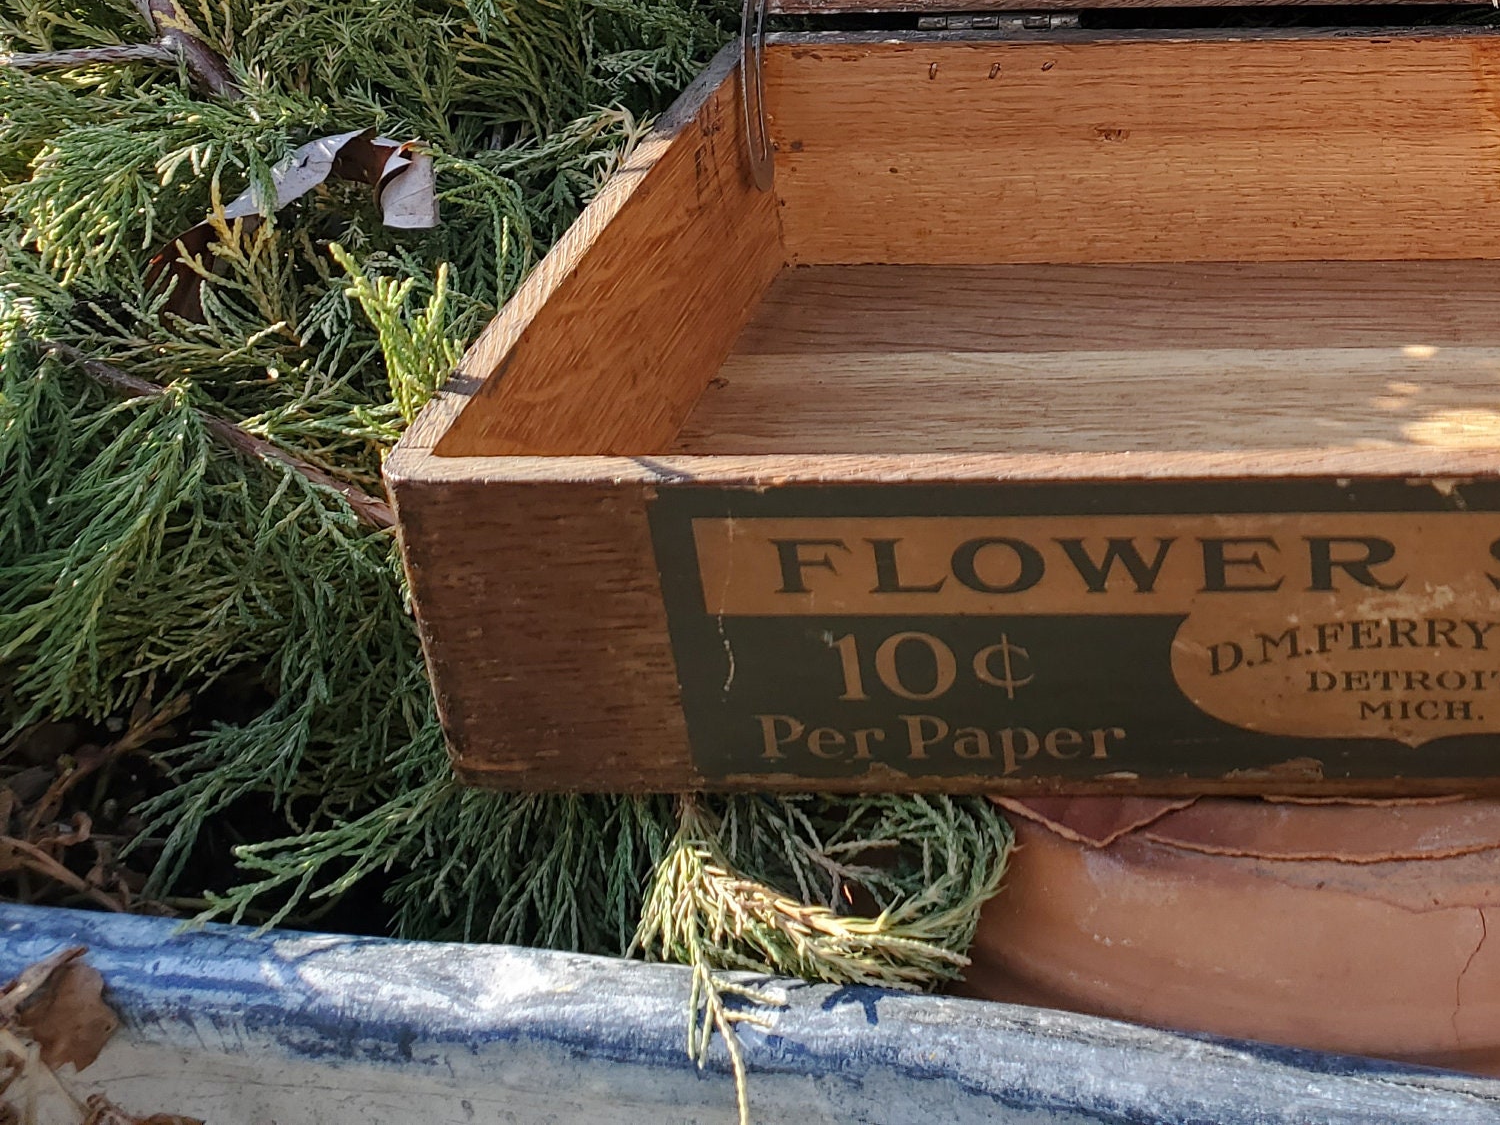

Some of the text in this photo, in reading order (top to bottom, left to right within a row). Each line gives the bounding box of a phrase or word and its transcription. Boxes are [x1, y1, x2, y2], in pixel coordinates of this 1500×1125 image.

[767, 534, 1408, 594] FLOWER
[1357, 698, 1485, 721] MICH.
[754, 714, 1126, 773] Per Paper
